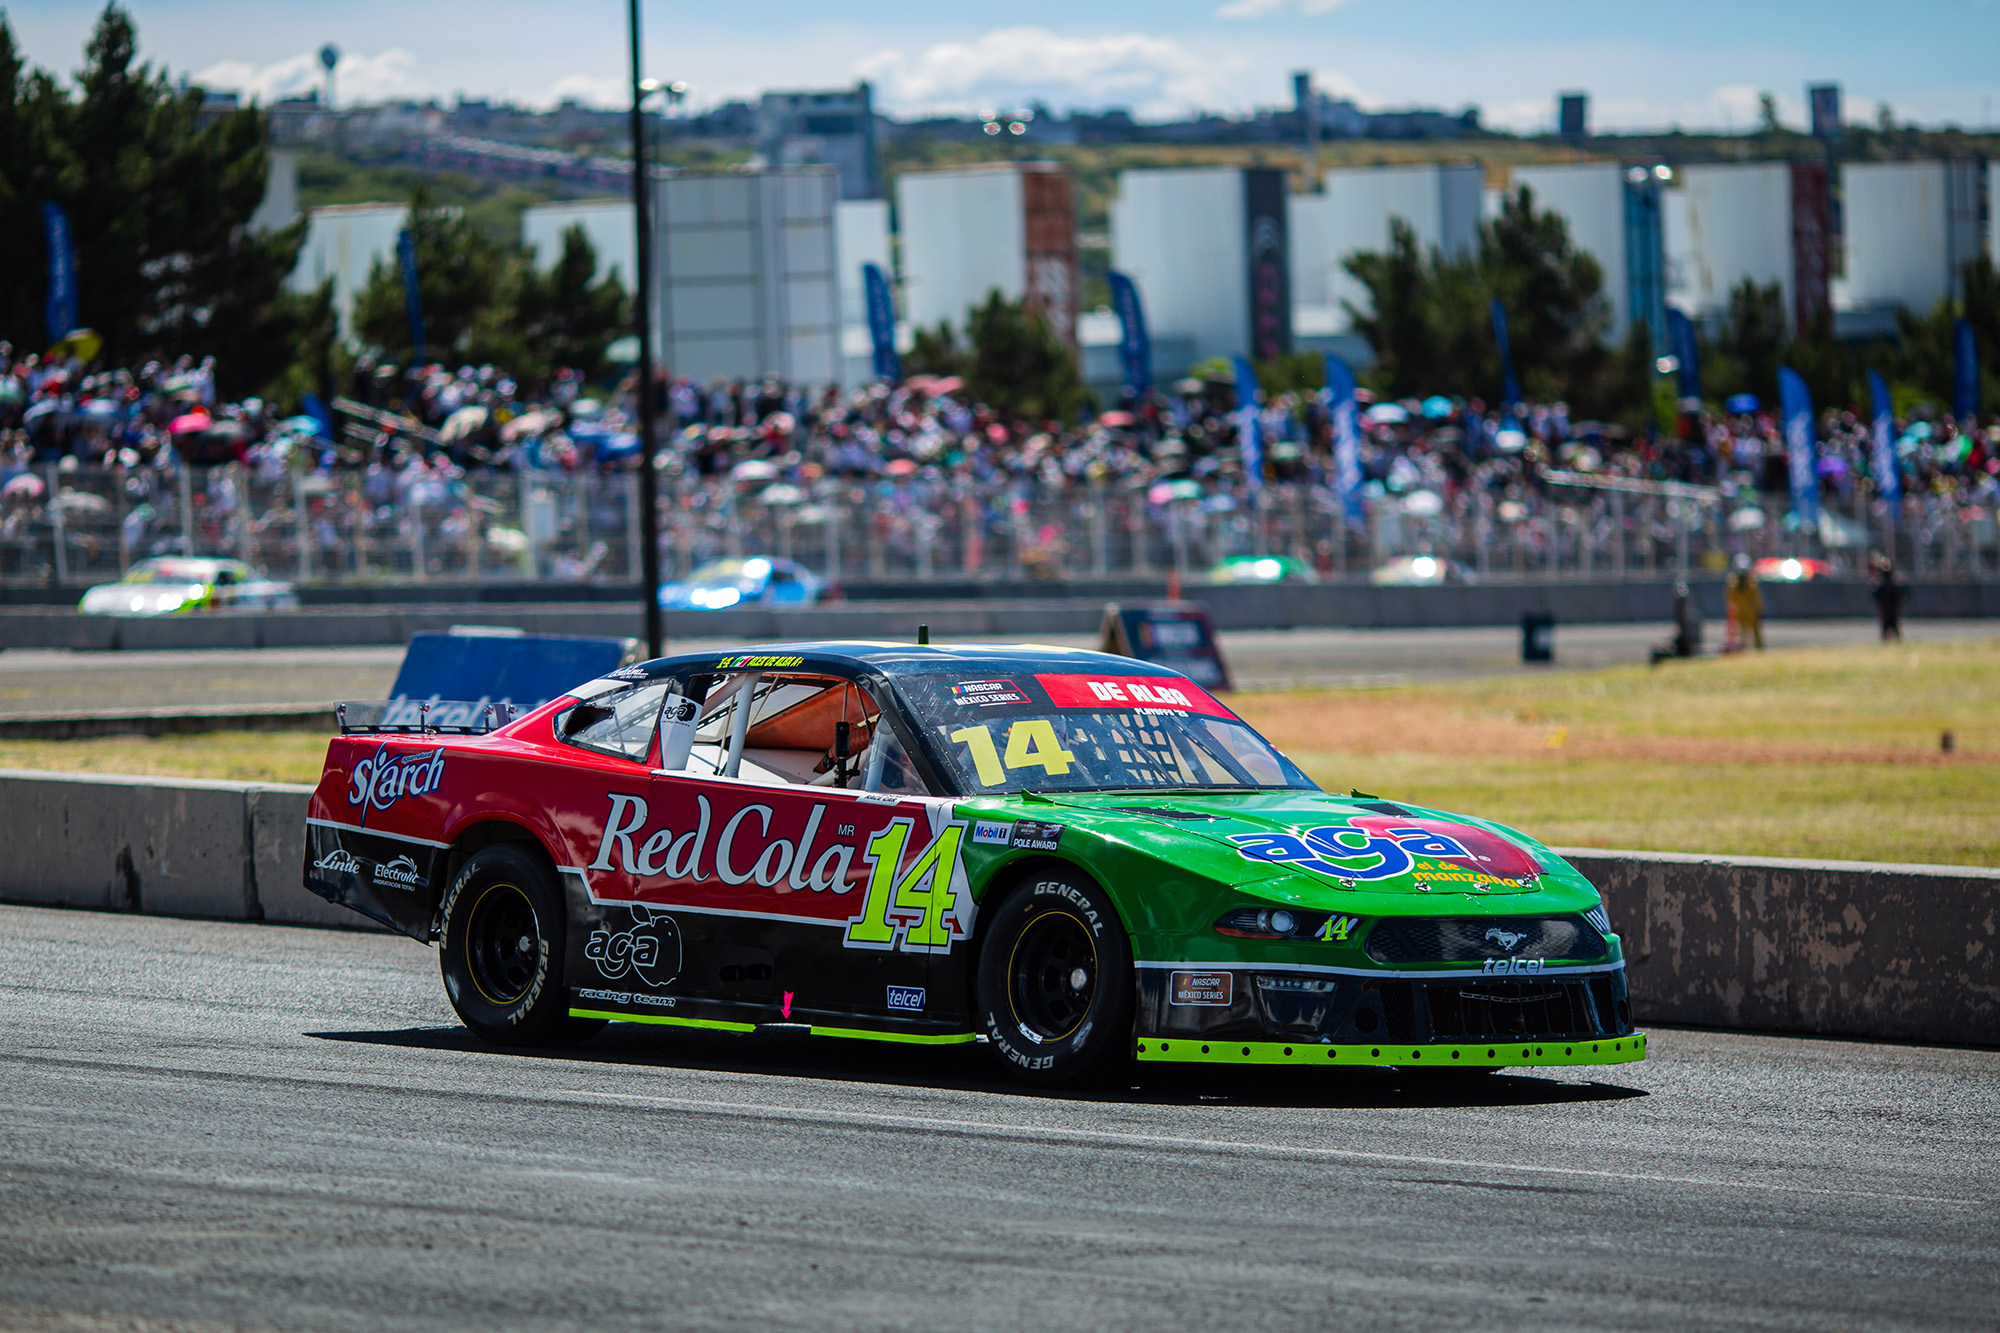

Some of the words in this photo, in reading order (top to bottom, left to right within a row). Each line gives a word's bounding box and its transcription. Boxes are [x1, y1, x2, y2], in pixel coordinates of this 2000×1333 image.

[716, 656, 734, 669] 14
[963, 682, 1003, 693] NASCAR
[1087, 681, 1129, 701] DE
[1126, 683, 1193, 708] ALBA
[953, 694, 990, 706] MÉXICO
[987, 693, 1020, 702] SERIES
[950, 720, 1076, 787] 14
[587, 791, 711, 882] Red
[715, 802, 858, 895] Cola
[837, 824, 856, 836] MR
[975, 826, 998, 838] Mobil
[999, 828, 1007, 839] 1
[1013, 838, 1031, 848] POLE
[1031, 840, 1058, 850] AWARD
[1225, 826, 1478, 882] aga
[313, 849, 360, 875] Linde
[1416, 861, 1435, 871] el
[1438, 861, 1461, 871] de
[374, 863, 420, 884] Electrolit
[1411, 871, 1521, 888] manzana
[843, 817, 969, 955] 14
[439, 863, 481, 950] GENERAL
[1033, 881, 1104, 938] GENERAL
[1320, 917, 1350, 942] 14
[584, 930, 659, 980] aga
[1481, 956, 1545, 975] telcel
[507, 938, 550, 1026] GENERAL
[1191, 978, 1221, 986] NASCAR
[578, 988, 632, 1003] racing
[632, 993, 677, 1007] team
[889, 989, 923, 1007] telcel
[1178, 990, 1202, 999] MÉXICO
[1202, 991, 1224, 1000] SERIES
[986, 1011, 1054, 1070] GENERAL
